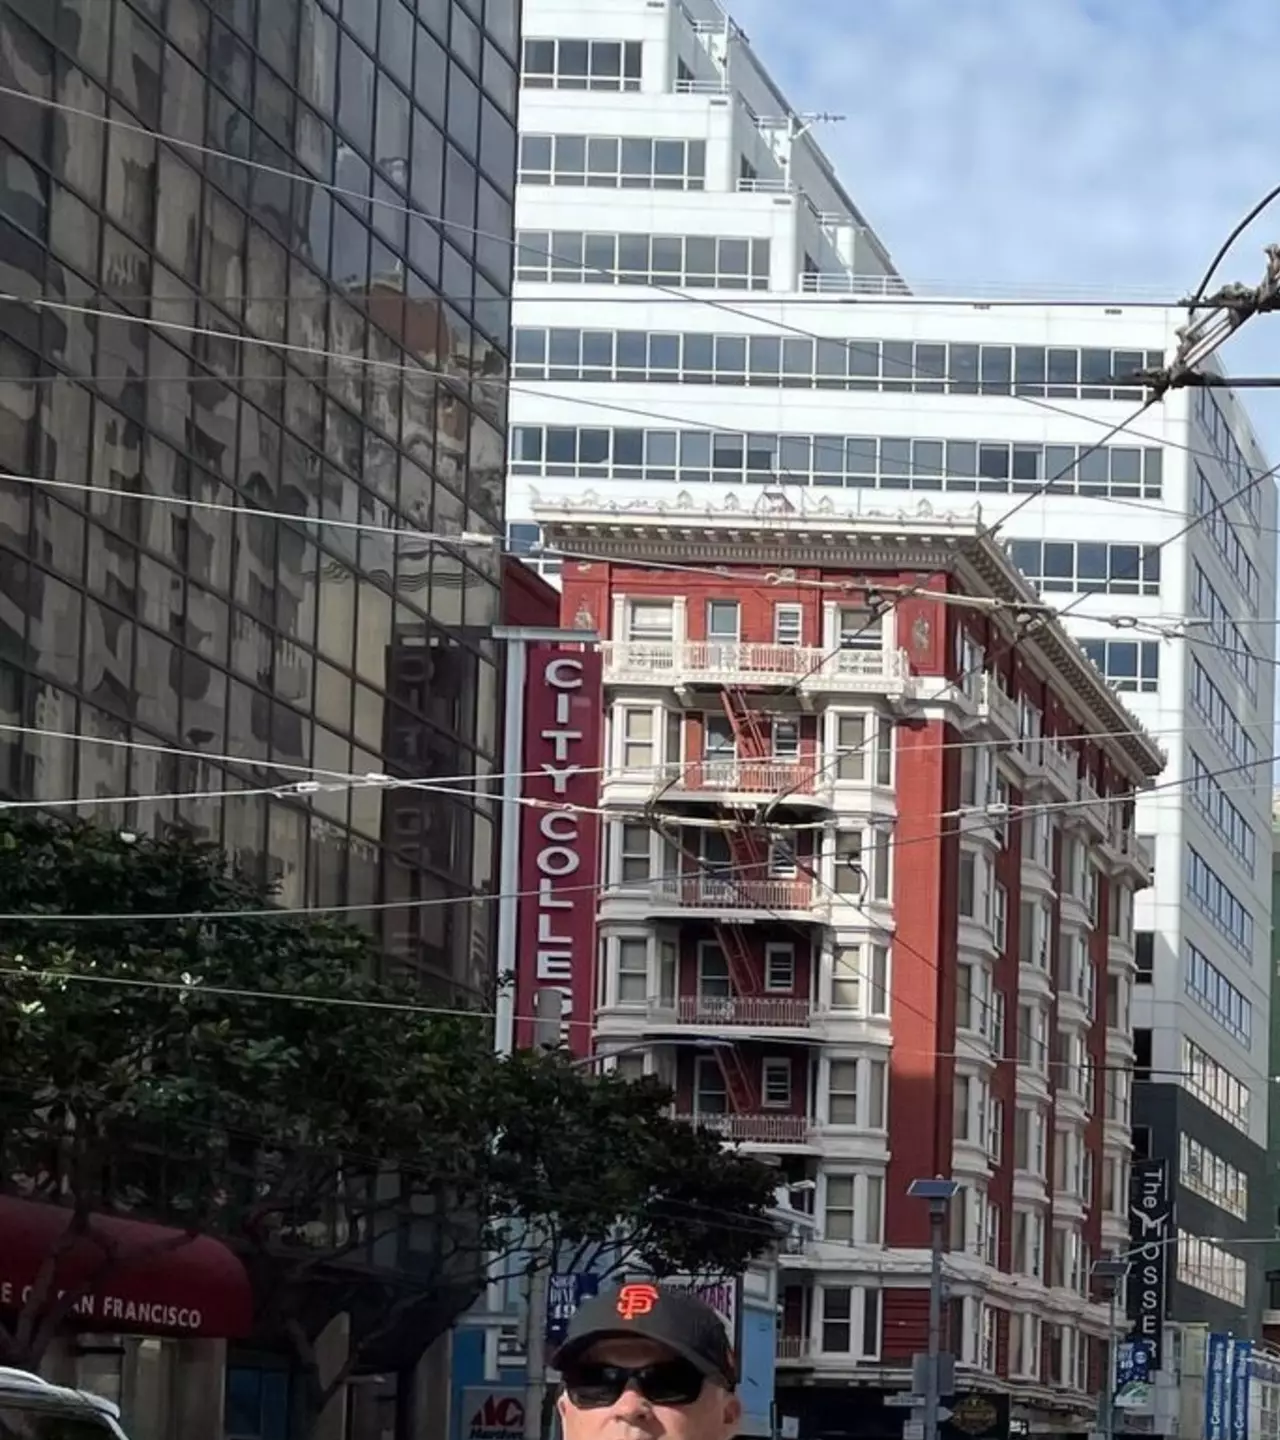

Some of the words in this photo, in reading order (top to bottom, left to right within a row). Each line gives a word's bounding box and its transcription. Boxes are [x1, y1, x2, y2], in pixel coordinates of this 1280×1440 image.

[541, 658, 583, 793] CITY
[536, 811, 578, 1051] COLLE
[1142, 1168, 1162, 1209] The
[103, 1296, 202, 1329] FRANCISCO
[617, 1283, 660, 1320] SF
[470, 1394, 524, 1426] AC
[1211, 1371, 1223, 1425] Container
[1234, 1378, 1245, 1429] Container
